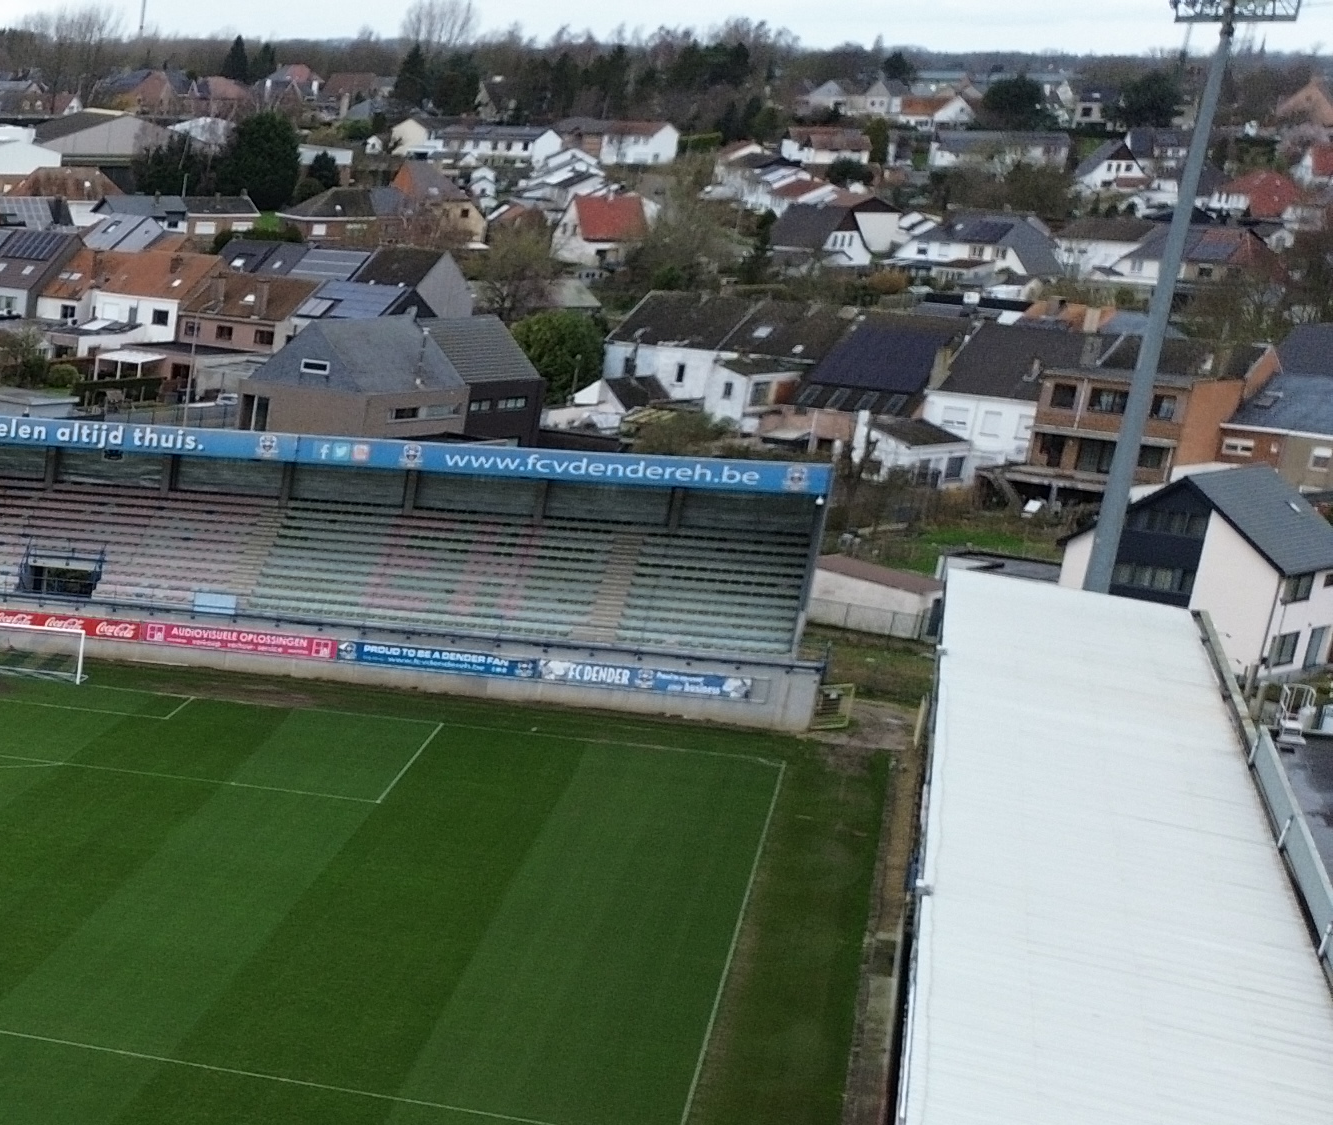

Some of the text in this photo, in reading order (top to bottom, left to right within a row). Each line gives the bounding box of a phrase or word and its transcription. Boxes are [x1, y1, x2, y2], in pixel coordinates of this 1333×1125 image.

[57, 422, 124, 449] altijd
[133, 427, 205, 451] thuis.
[444, 450, 761, 486] www.fcvdendereh.be
[95, 621, 137, 638] Coca-Cola
[239, 633, 308, 648] OPLOSSINGEN
[363, 644, 509, 667] PROUD TO BE A DENDER FAN
[568, 664, 631, 685] FC DENDER
